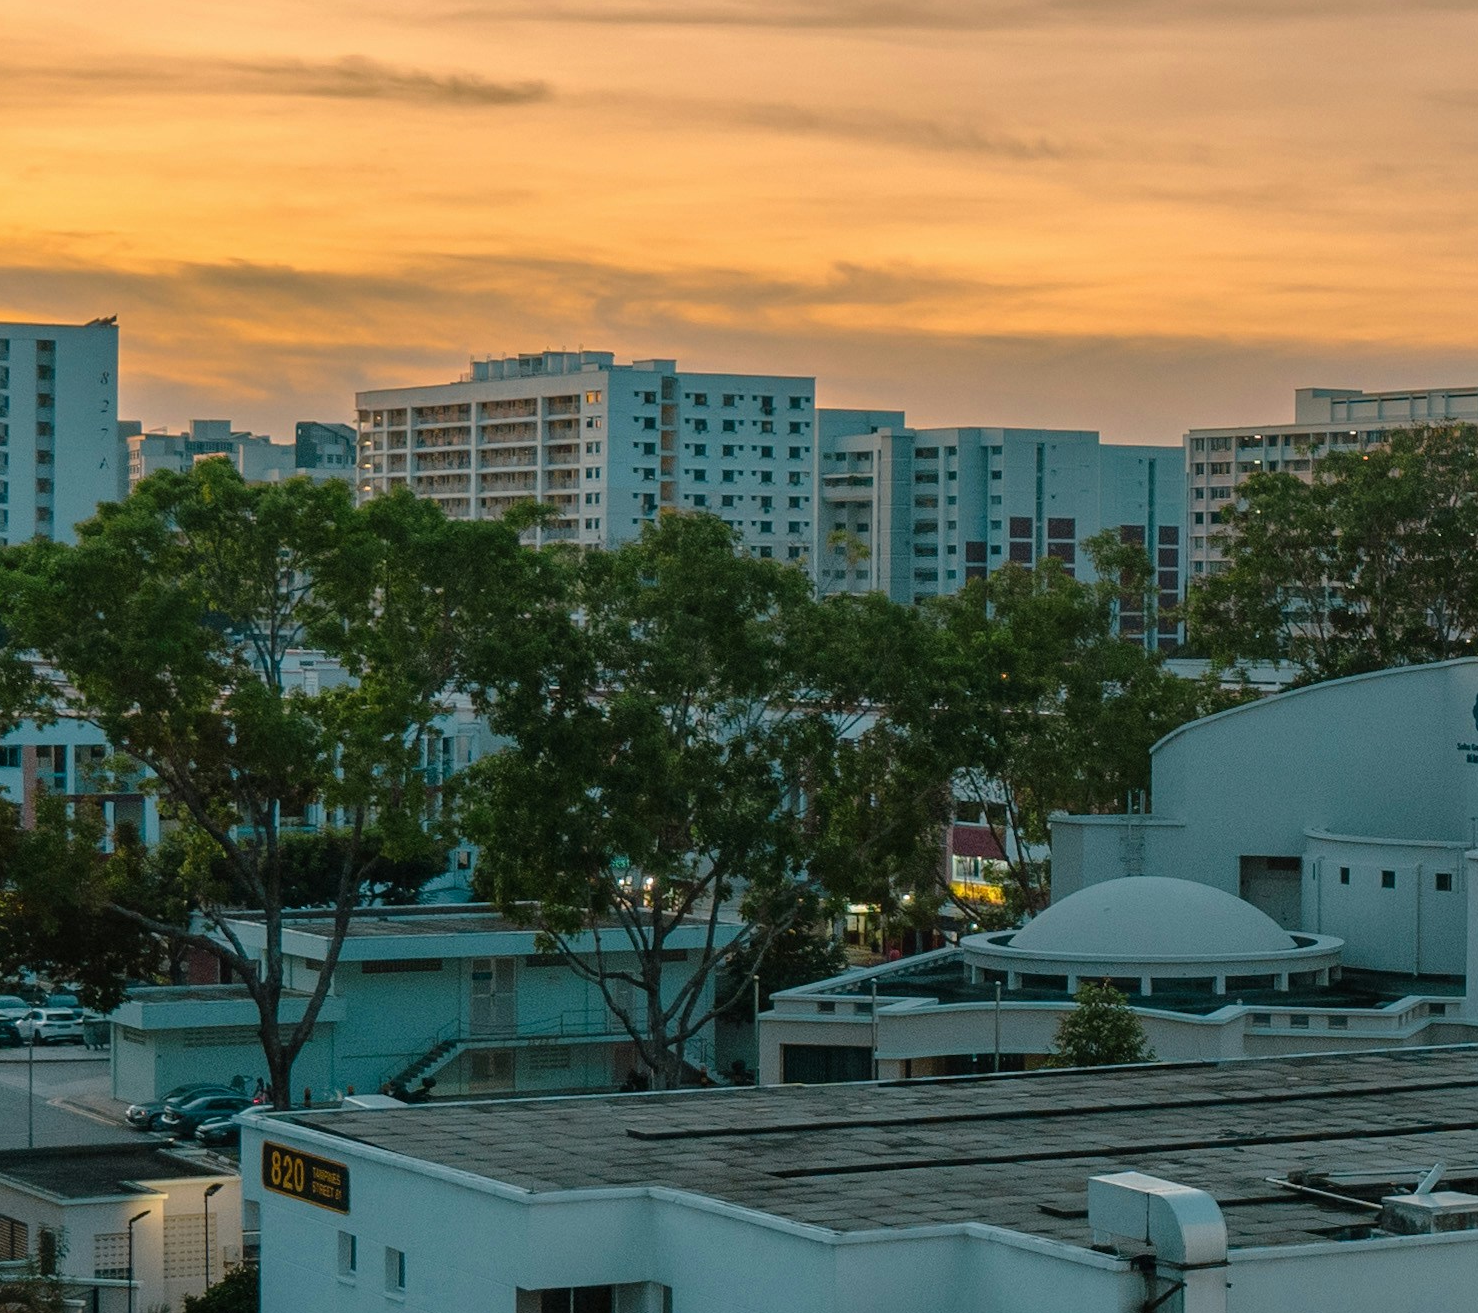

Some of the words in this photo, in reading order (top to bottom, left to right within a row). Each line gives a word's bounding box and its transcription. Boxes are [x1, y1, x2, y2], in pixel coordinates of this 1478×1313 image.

[99, 370, 110, 470] 827A
[271, 1150, 305, 1192] 820
[312, 1181, 334, 1197] STREET
